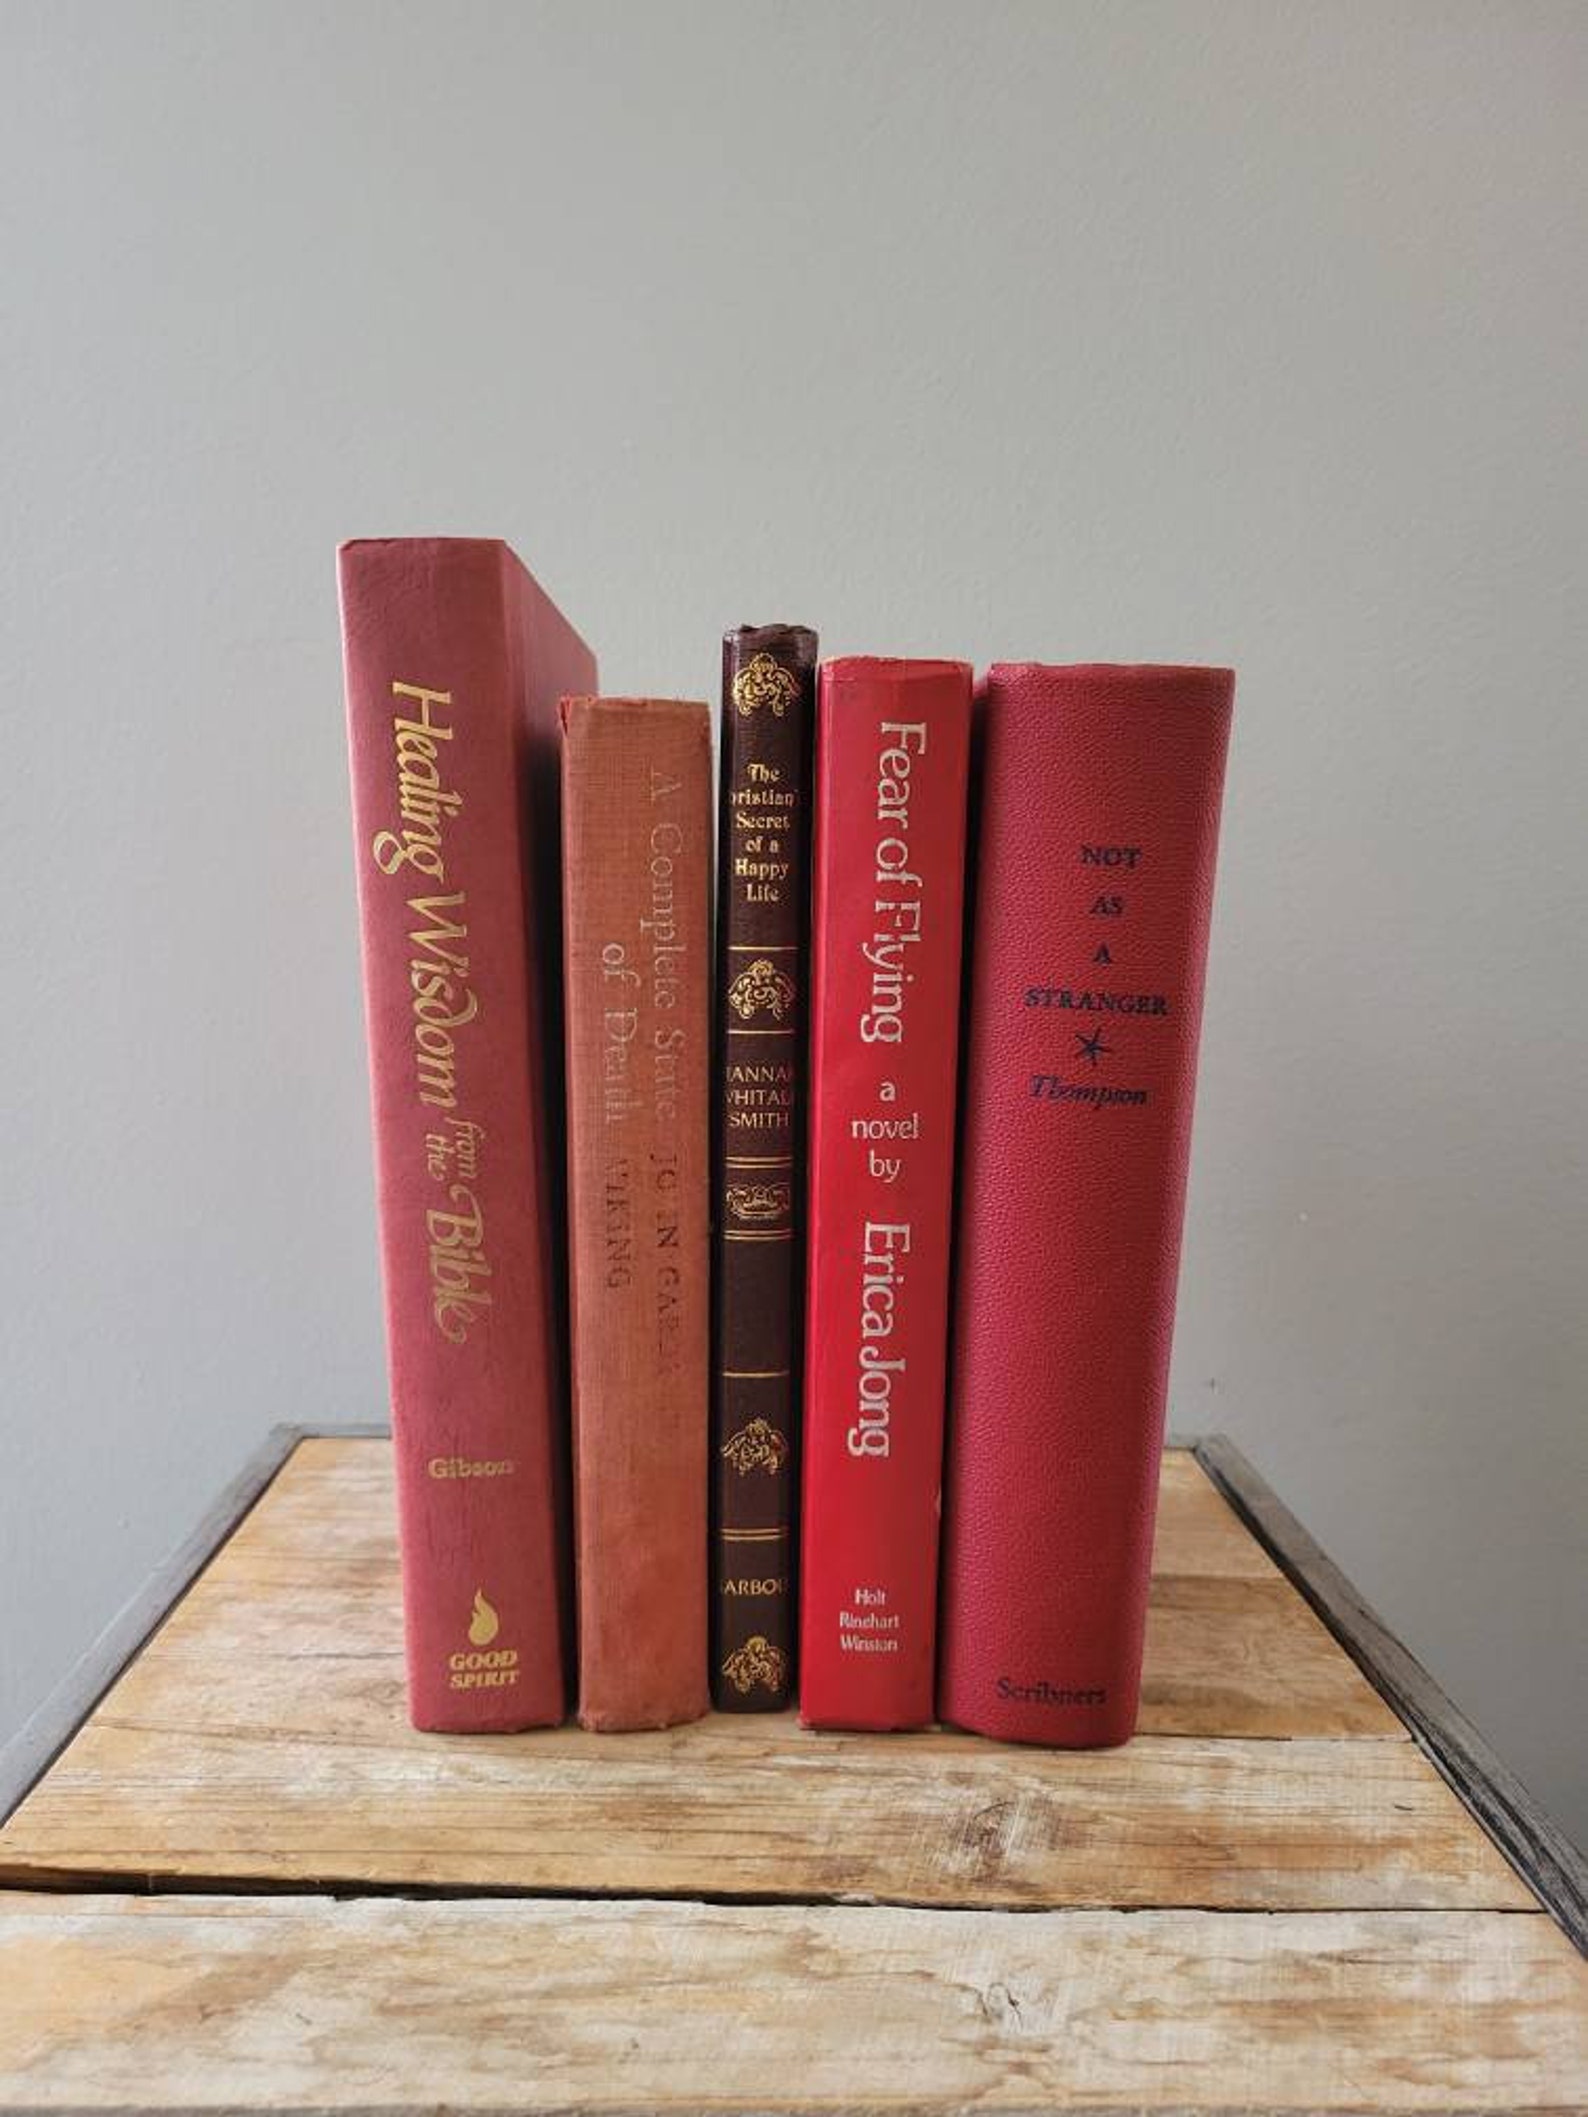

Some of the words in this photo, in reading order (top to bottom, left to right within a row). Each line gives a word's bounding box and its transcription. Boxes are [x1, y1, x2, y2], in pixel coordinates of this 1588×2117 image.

[374, 681, 464, 883] Healing
[649, 768, 683, 802] A
[747, 763, 781, 783] The
[876, 721, 928, 829] Fear
[735, 811, 791, 832] Secret
[744, 834, 764, 852] of
[769, 837, 780, 852] a
[1080, 844, 1142, 868] NOT
[735, 858, 790, 882] Happy
[875, 837, 924, 888] of
[746, 884, 780, 903] Life
[1088, 896, 1124, 916] AS
[640, 823, 688, 1010] Complete
[602, 943, 642, 988] of
[1092, 942, 1113, 965] A
[860, 899, 922, 1043] Flying
[407, 892, 478, 1108] Wisdom
[1023, 984, 1169, 1016] STRANGER
[879, 1081, 897, 1102] a
[1030, 1074, 1149, 1110] Thompson
[729, 1112, 790, 1129] SMITH
[850, 1112, 920, 1140] novel
[425, 1134, 456, 1182] the
[445, 1117, 486, 1179] from
[868, 1149, 902, 1183] by
[426, 1184, 493, 1344] Bible
[861, 1222, 912, 1338] Erica
[847, 1345, 907, 1457] Jong
[428, 1457, 516, 1480] Gibson
[854, 1588, 887, 1606] Holt
[839, 1611, 900, 1629] Rinehart
[840, 1634, 899, 1652] Winston
[450, 1650, 519, 1671] GOOD
[450, 1670, 520, 1689] SPIRIT
[996, 1676, 1108, 1706] Scribners
